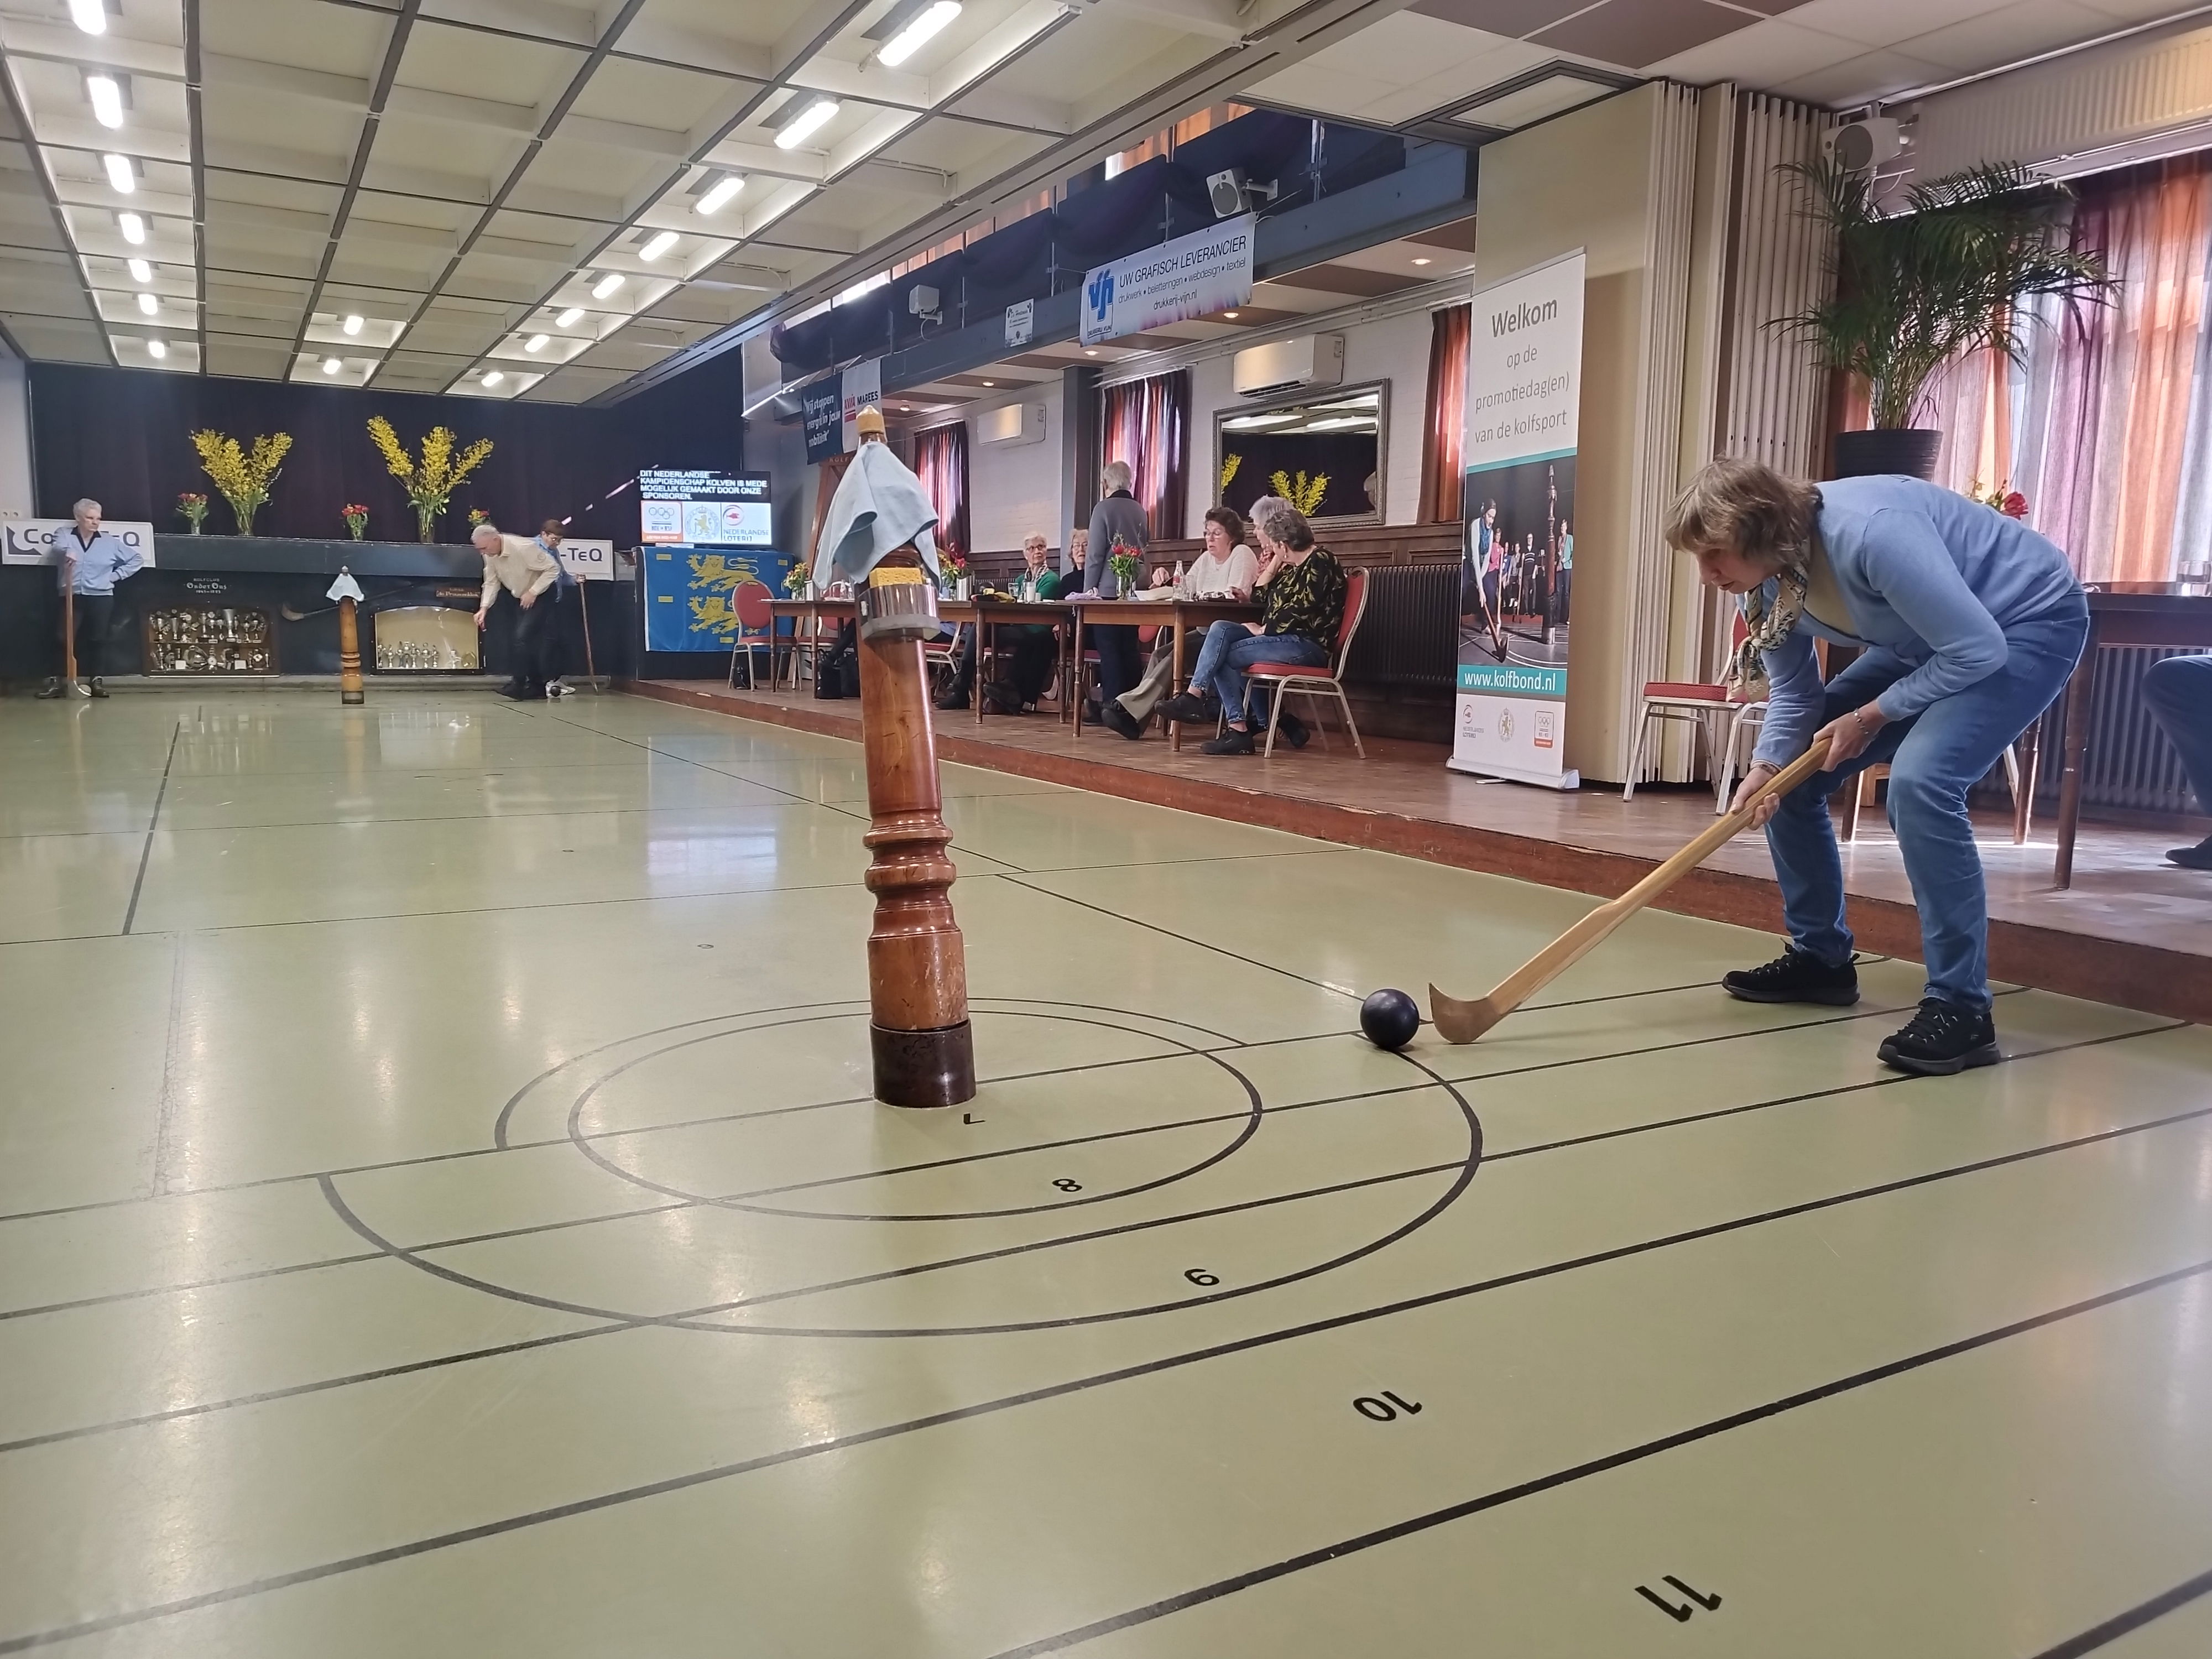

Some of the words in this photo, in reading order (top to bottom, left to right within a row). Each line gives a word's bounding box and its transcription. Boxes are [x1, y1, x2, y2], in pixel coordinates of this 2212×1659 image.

[1119, 272, 1134, 288] UW
[1135, 257, 1178, 283] GRAFISCH
[1181, 235, 1246, 269] LEVERANCIER
[1118, 289, 1142, 304] drukwerk
[1147, 276, 1183, 295] beletteringen
[1188, 265, 1220, 282] webdesign
[1227, 257, 1246, 271] textiel
[1153, 289, 1198, 310] drukkerij-vijn.nl
[1492, 299, 1557, 338] Welkom
[1506, 352, 1520, 370] op
[1524, 344, 1537, 363] de
[857, 390, 878, 405] MAREES
[1475, 371, 1569, 414] promotiedag(en)
[1475, 427, 1493, 443] van
[1497, 421, 1511, 439] de
[1514, 409, 1567, 435] kolfsport
[640, 477, 705, 486] KAMPIOENSCHAP
[654, 470, 710, 479] NEDERLANDSE
[680, 486, 716, 494] GEMAAKT
[1464, 669, 1556, 691] www.kolfbond.nl
[1052, 1178, 1082, 1193] 8
[1353, 1391, 1423, 1422] 10
[1634, 1575, 1723, 1623] 11
